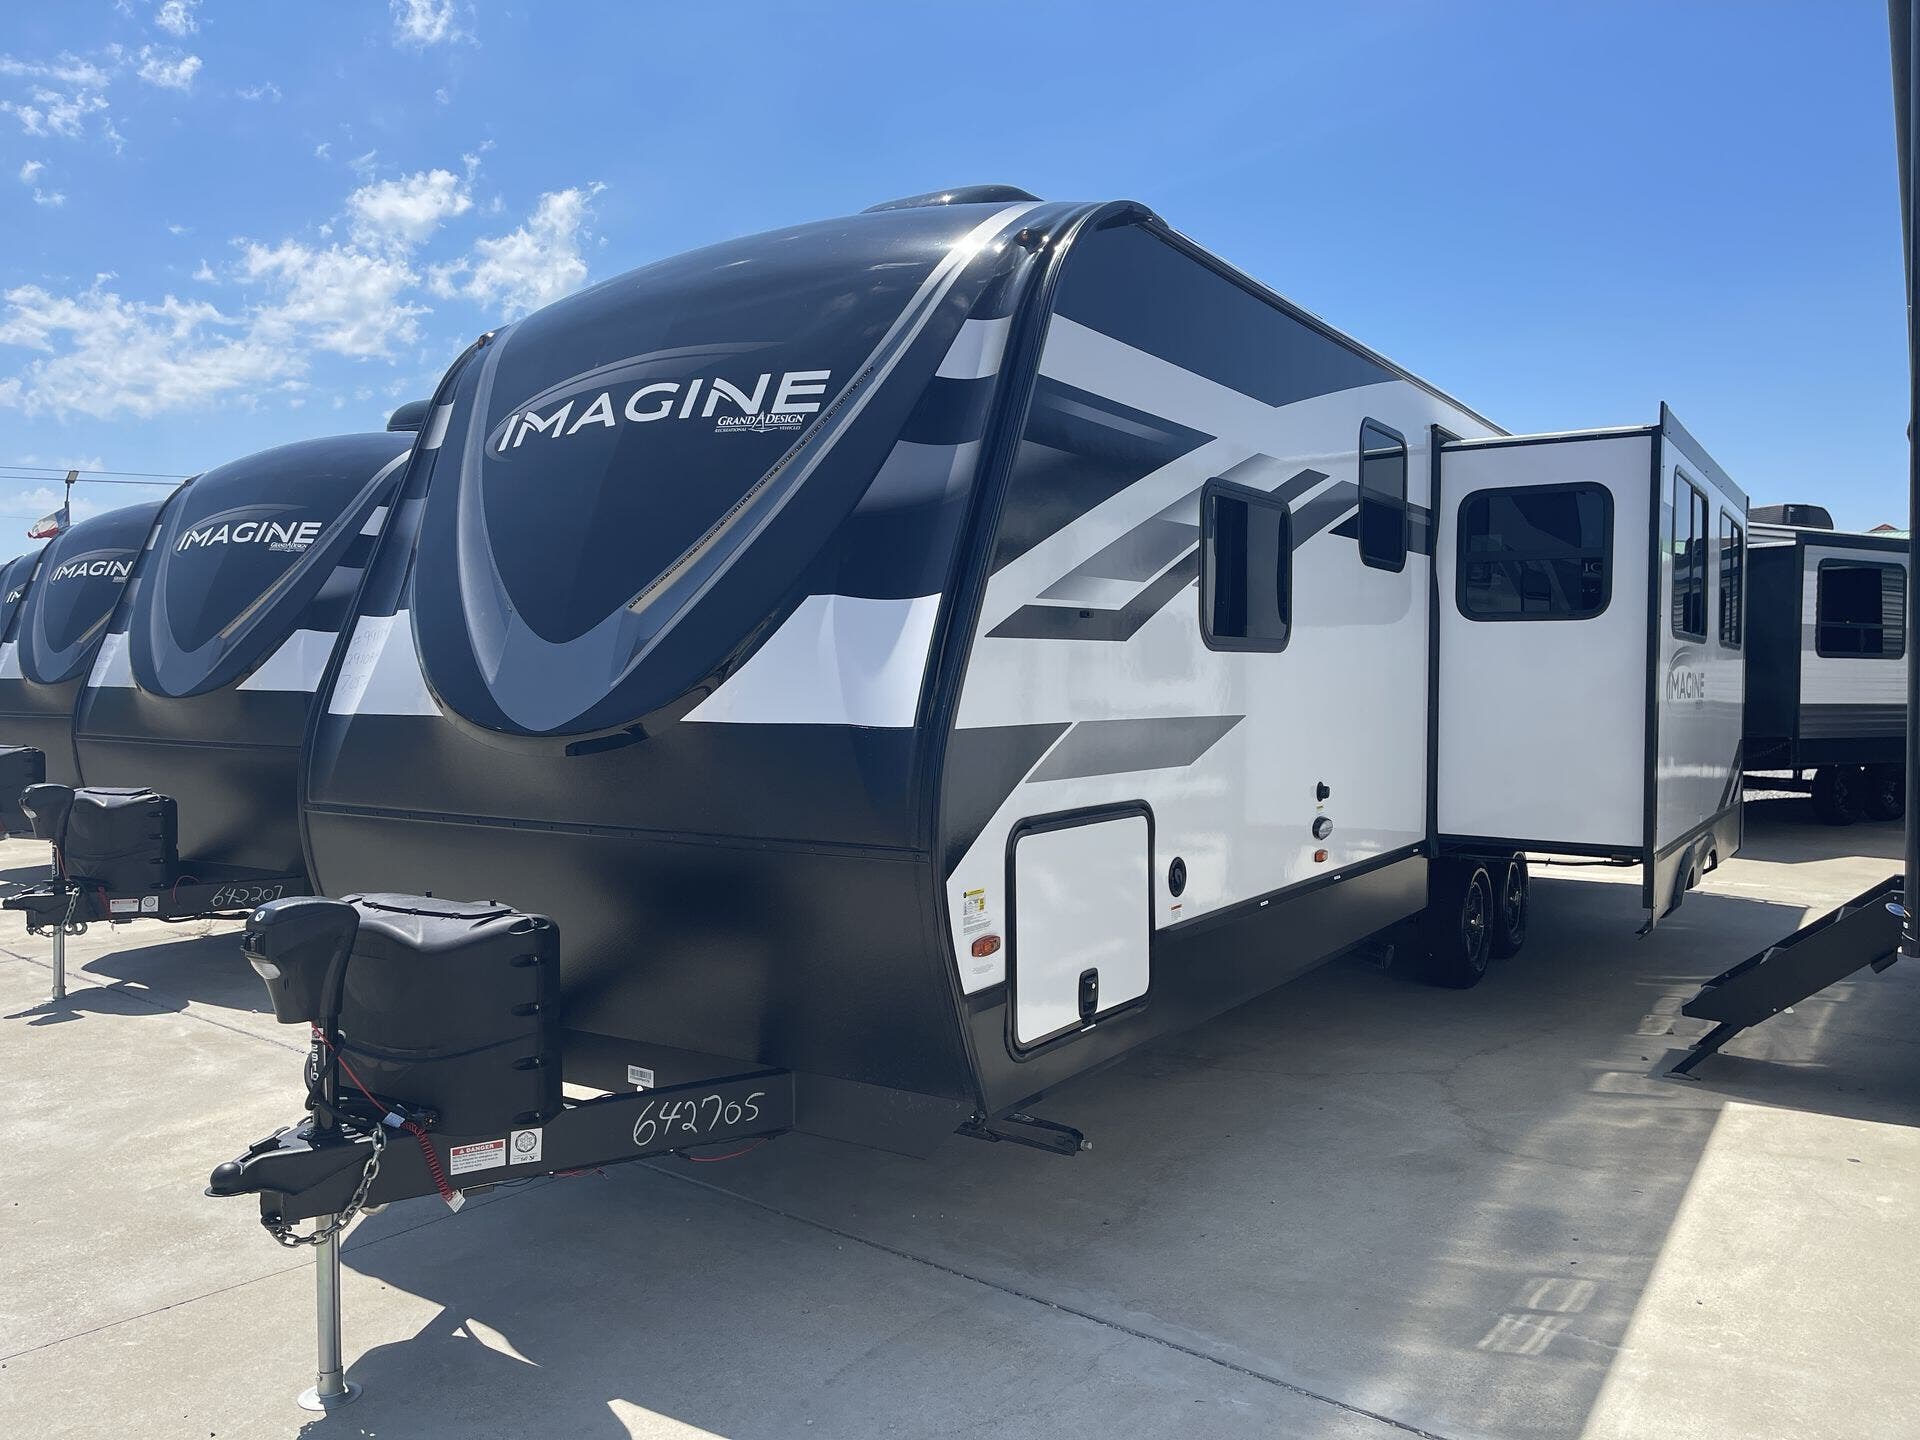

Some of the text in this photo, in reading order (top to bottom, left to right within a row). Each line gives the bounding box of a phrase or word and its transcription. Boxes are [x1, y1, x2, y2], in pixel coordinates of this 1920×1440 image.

[497, 369, 832, 452] IMAGINE
[176, 521, 323, 552] IMAGINE
[53, 560, 134, 581] IMAGIN
[1668, 671, 1705, 700] IMAGINE
[210, 885, 283, 907] 642207
[632, 1092, 766, 1147] 642705
[466, 1143, 495, 1154] DANGER
